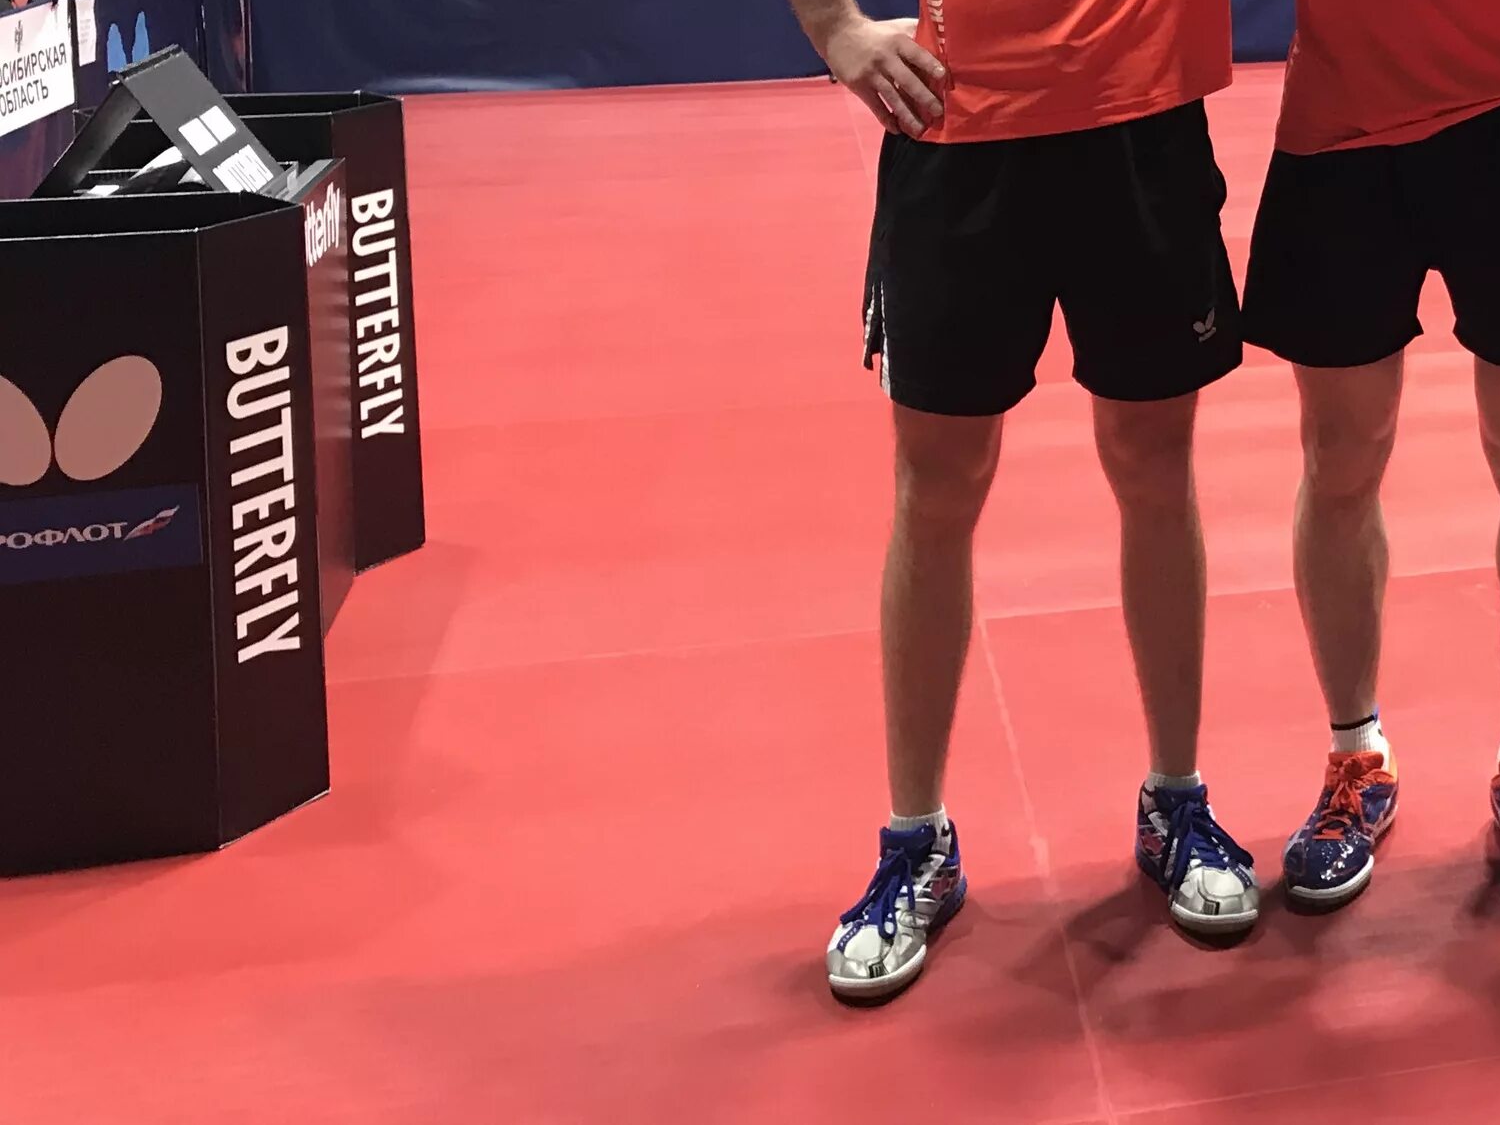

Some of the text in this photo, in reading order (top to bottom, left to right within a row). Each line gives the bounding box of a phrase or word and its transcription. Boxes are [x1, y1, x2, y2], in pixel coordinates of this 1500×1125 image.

[0, 42, 67, 87] СИБИРСКАЯ
[0, 78, 49, 117] ОБЛАСТЬ
[351, 188, 405, 439] BUTTERFLY
[225, 325, 301, 664] BUTTERFLY
